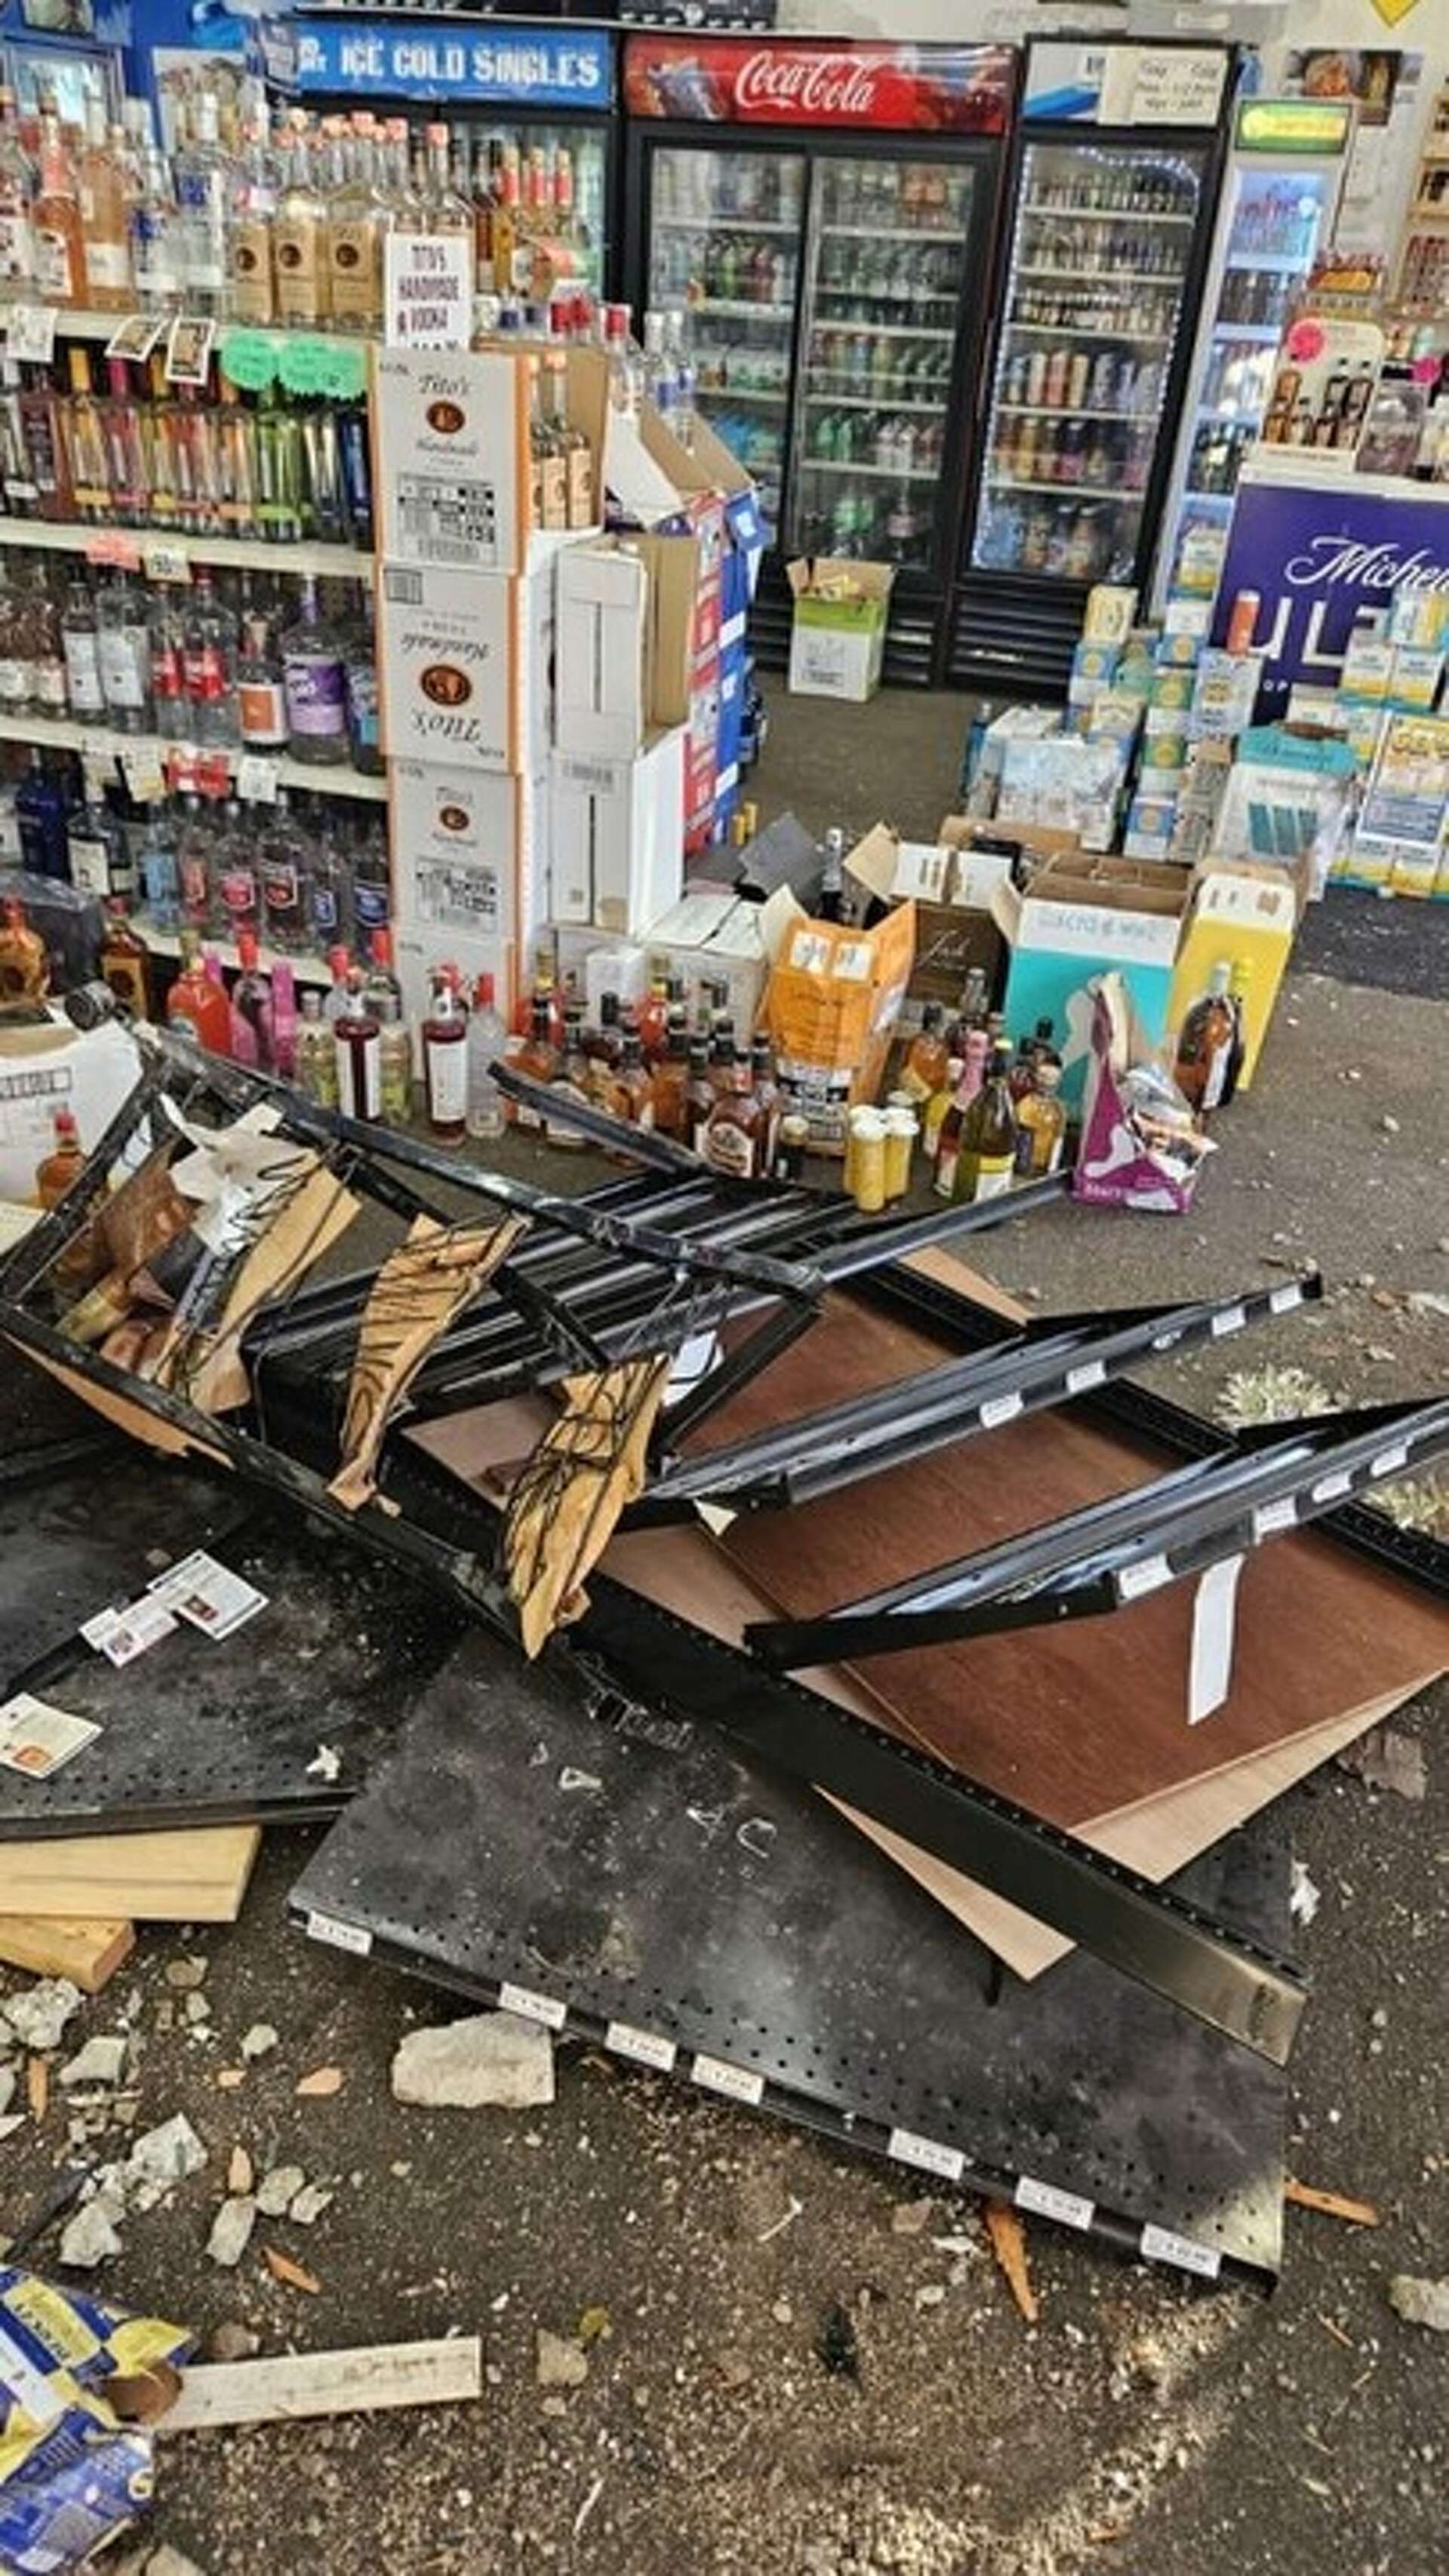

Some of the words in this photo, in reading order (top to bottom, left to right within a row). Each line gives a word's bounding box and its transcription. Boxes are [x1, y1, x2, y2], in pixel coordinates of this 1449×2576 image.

[340, 35, 383, 76] ICE
[392, 40, 466, 80] COLD
[473, 41, 600, 87] SINGLES
[735, 49, 875, 112] Coca-Cola
[412, 709, 481, 742] Tito's
